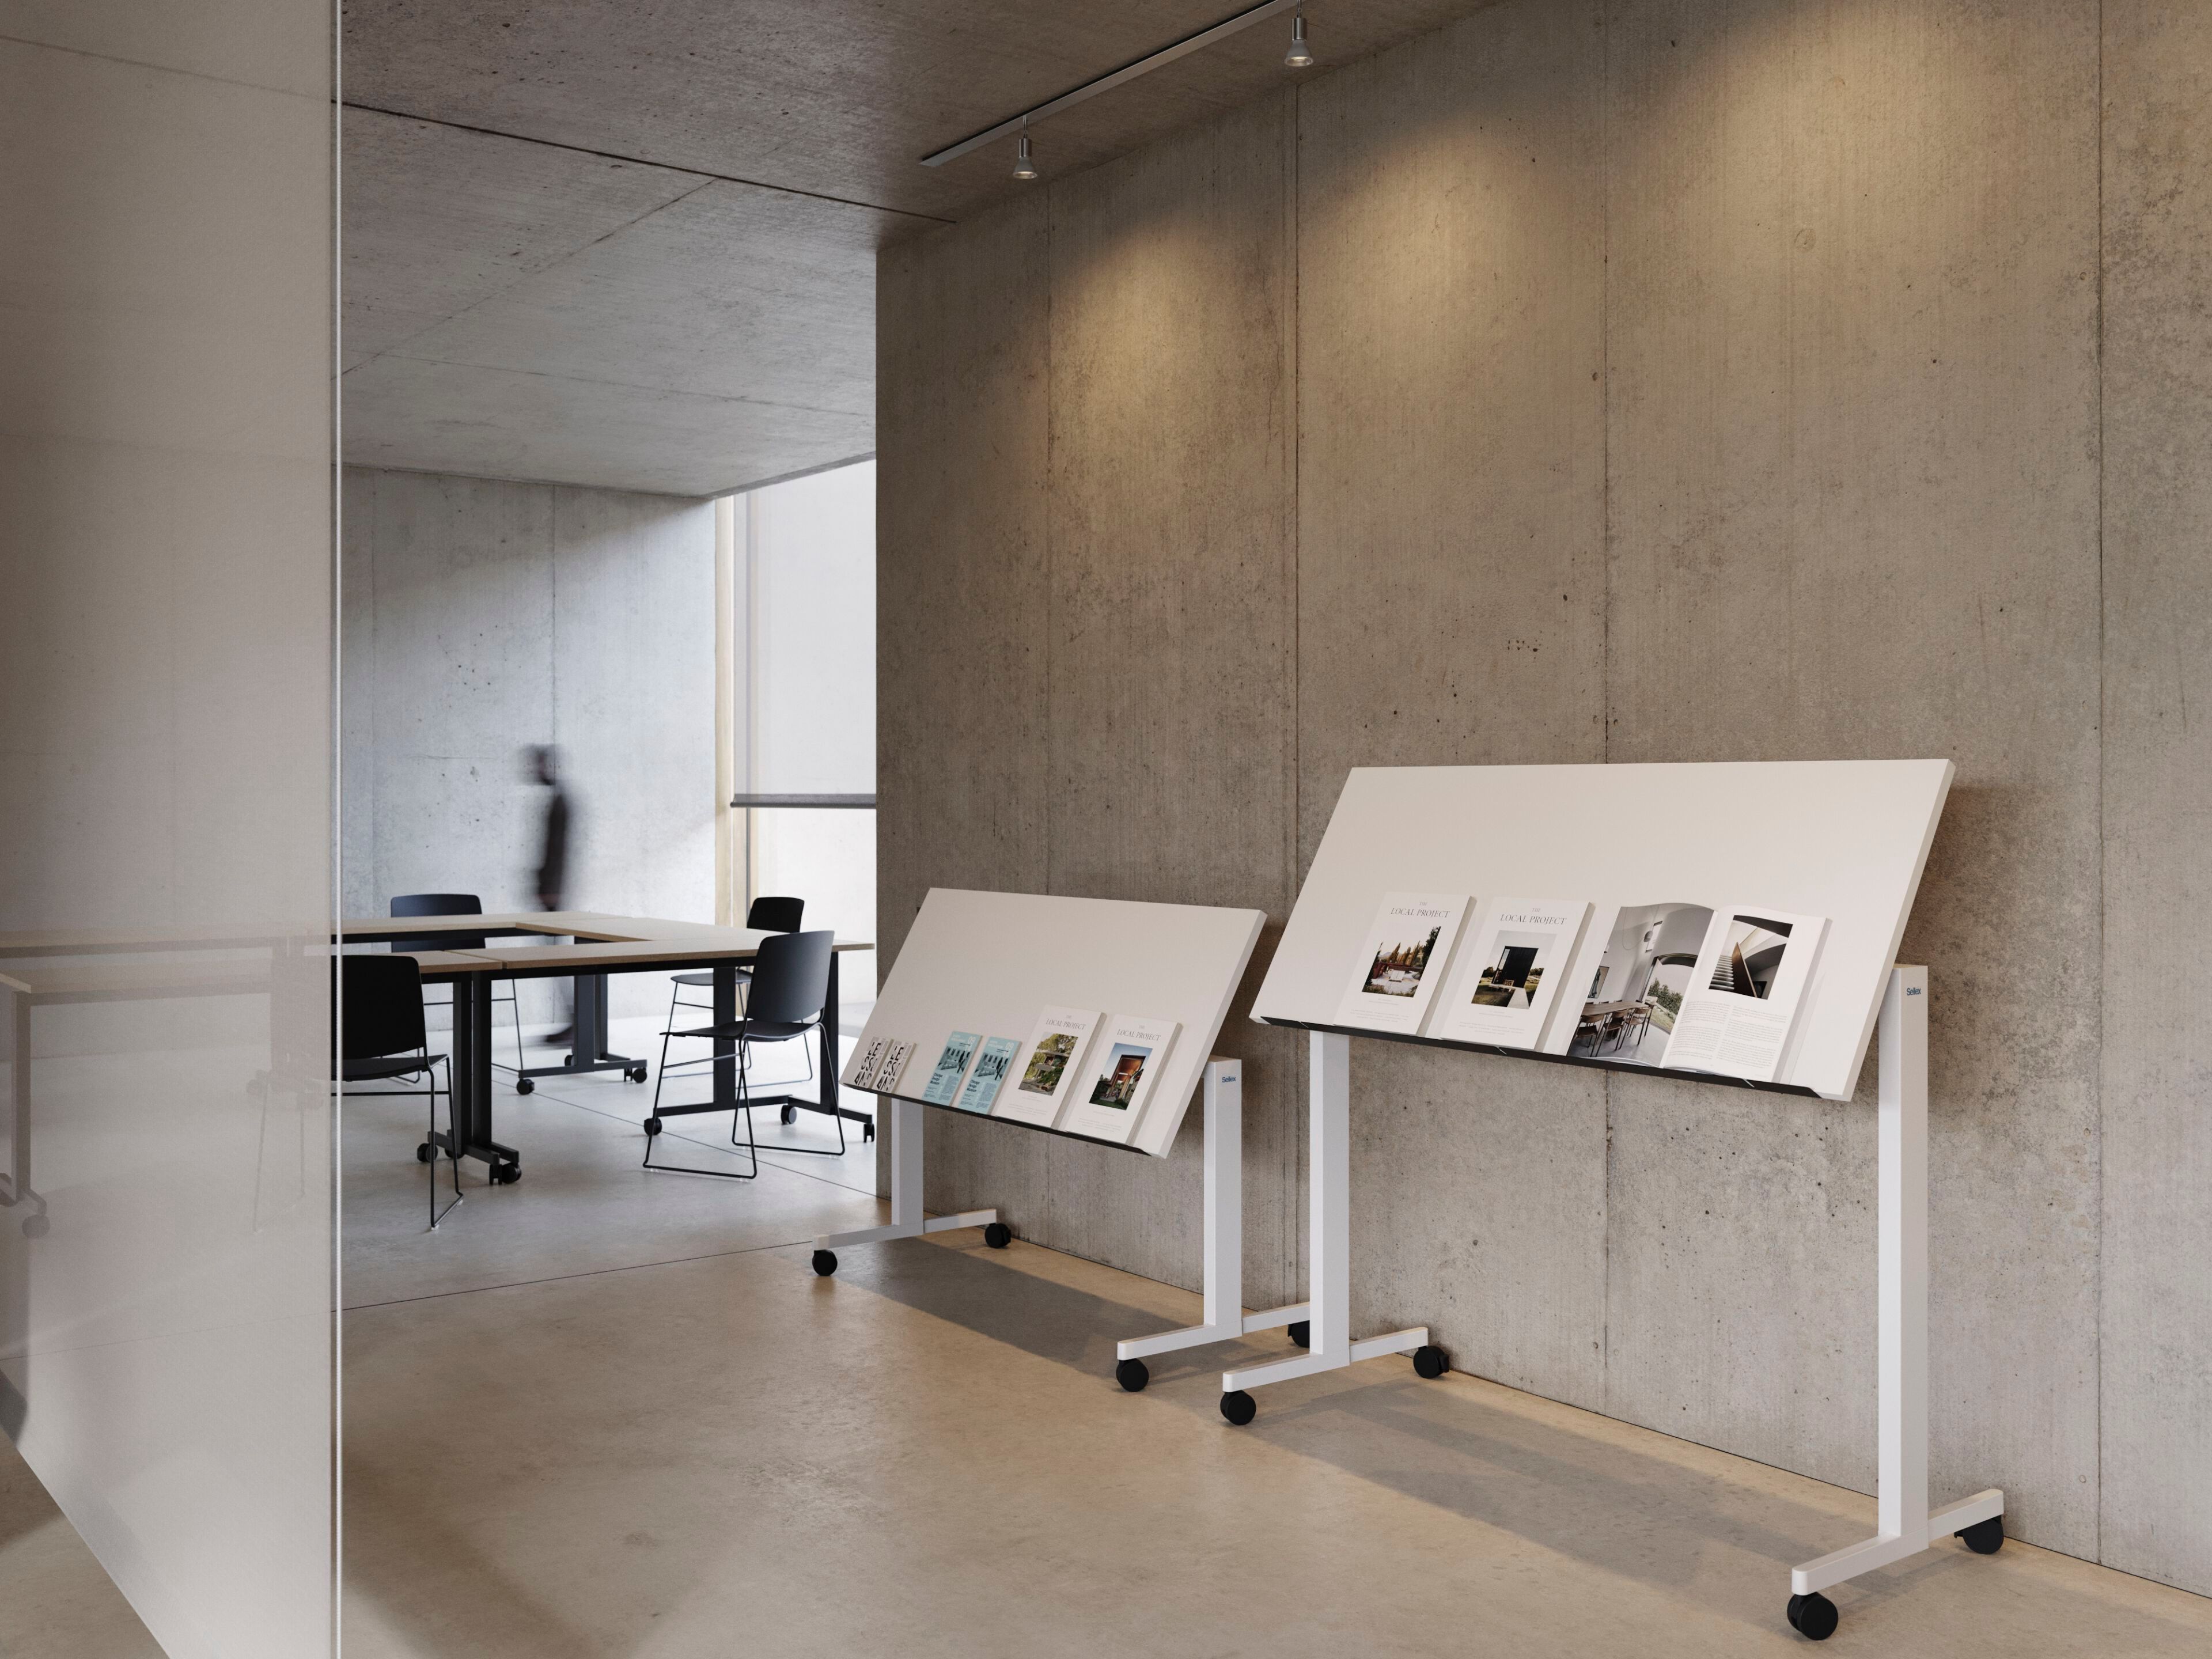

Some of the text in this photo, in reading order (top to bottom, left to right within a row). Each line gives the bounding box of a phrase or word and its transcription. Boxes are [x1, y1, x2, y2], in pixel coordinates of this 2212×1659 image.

[1391, 907, 1450, 918] LOCAL PROJECT
[1500, 914, 1567, 925] LOCAL PROJECT
[1046, 1018, 1086, 1030] LOCAL PROJECT
[1117, 1029, 1161, 1041] LOCAL PROJECT
